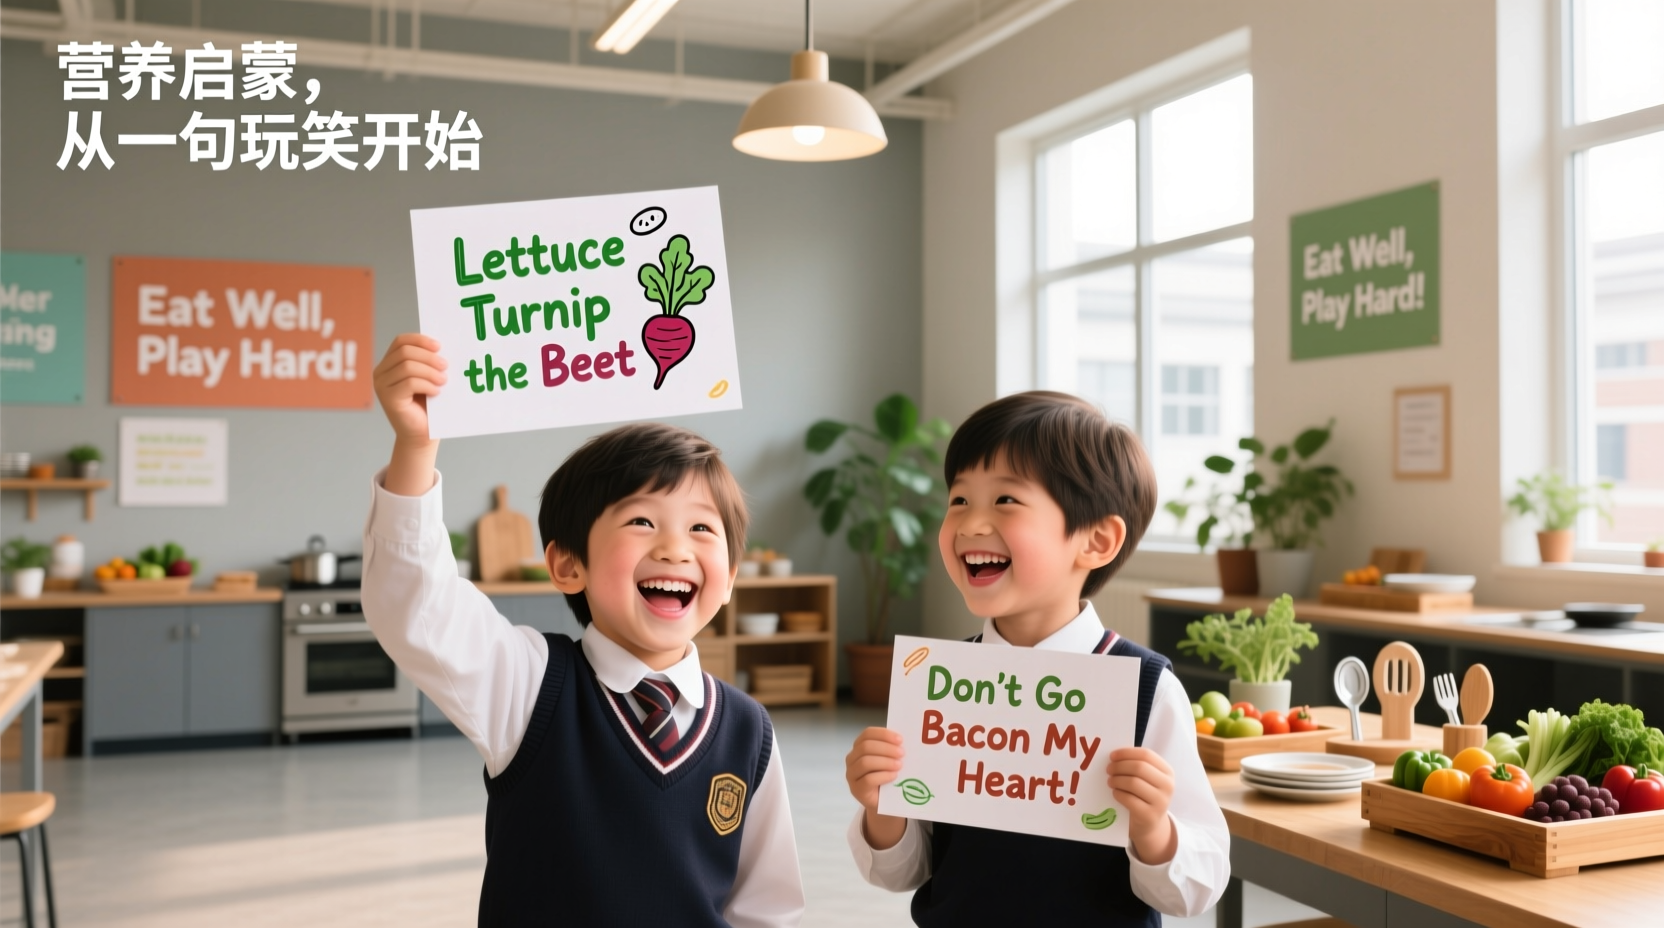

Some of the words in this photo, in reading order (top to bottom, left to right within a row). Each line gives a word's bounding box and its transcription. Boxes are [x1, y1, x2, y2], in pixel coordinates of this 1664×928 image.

[453, 234, 626, 286] Lettuce
[1303, 243, 1344, 280] Eat
[1348, 226, 1414, 271] Well,
[138, 284, 214, 328] Eat
[226, 288, 335, 339] Well,
[460, 287, 611, 342] Turnip
[1301, 289, 1351, 331] Play
[1354, 271, 1425, 318] Hard!
[137, 335, 230, 388] Play
[239, 338, 358, 382] Hard!
[464, 354, 529, 394] the
[540, 340, 637, 388] Beet
[927, 665, 1022, 707] Don't
[1035, 675, 1086, 712] Go
[921, 709, 1030, 754] Bacon
[1043, 723, 1101, 771] My
[957, 759, 1080, 806] Heart!
